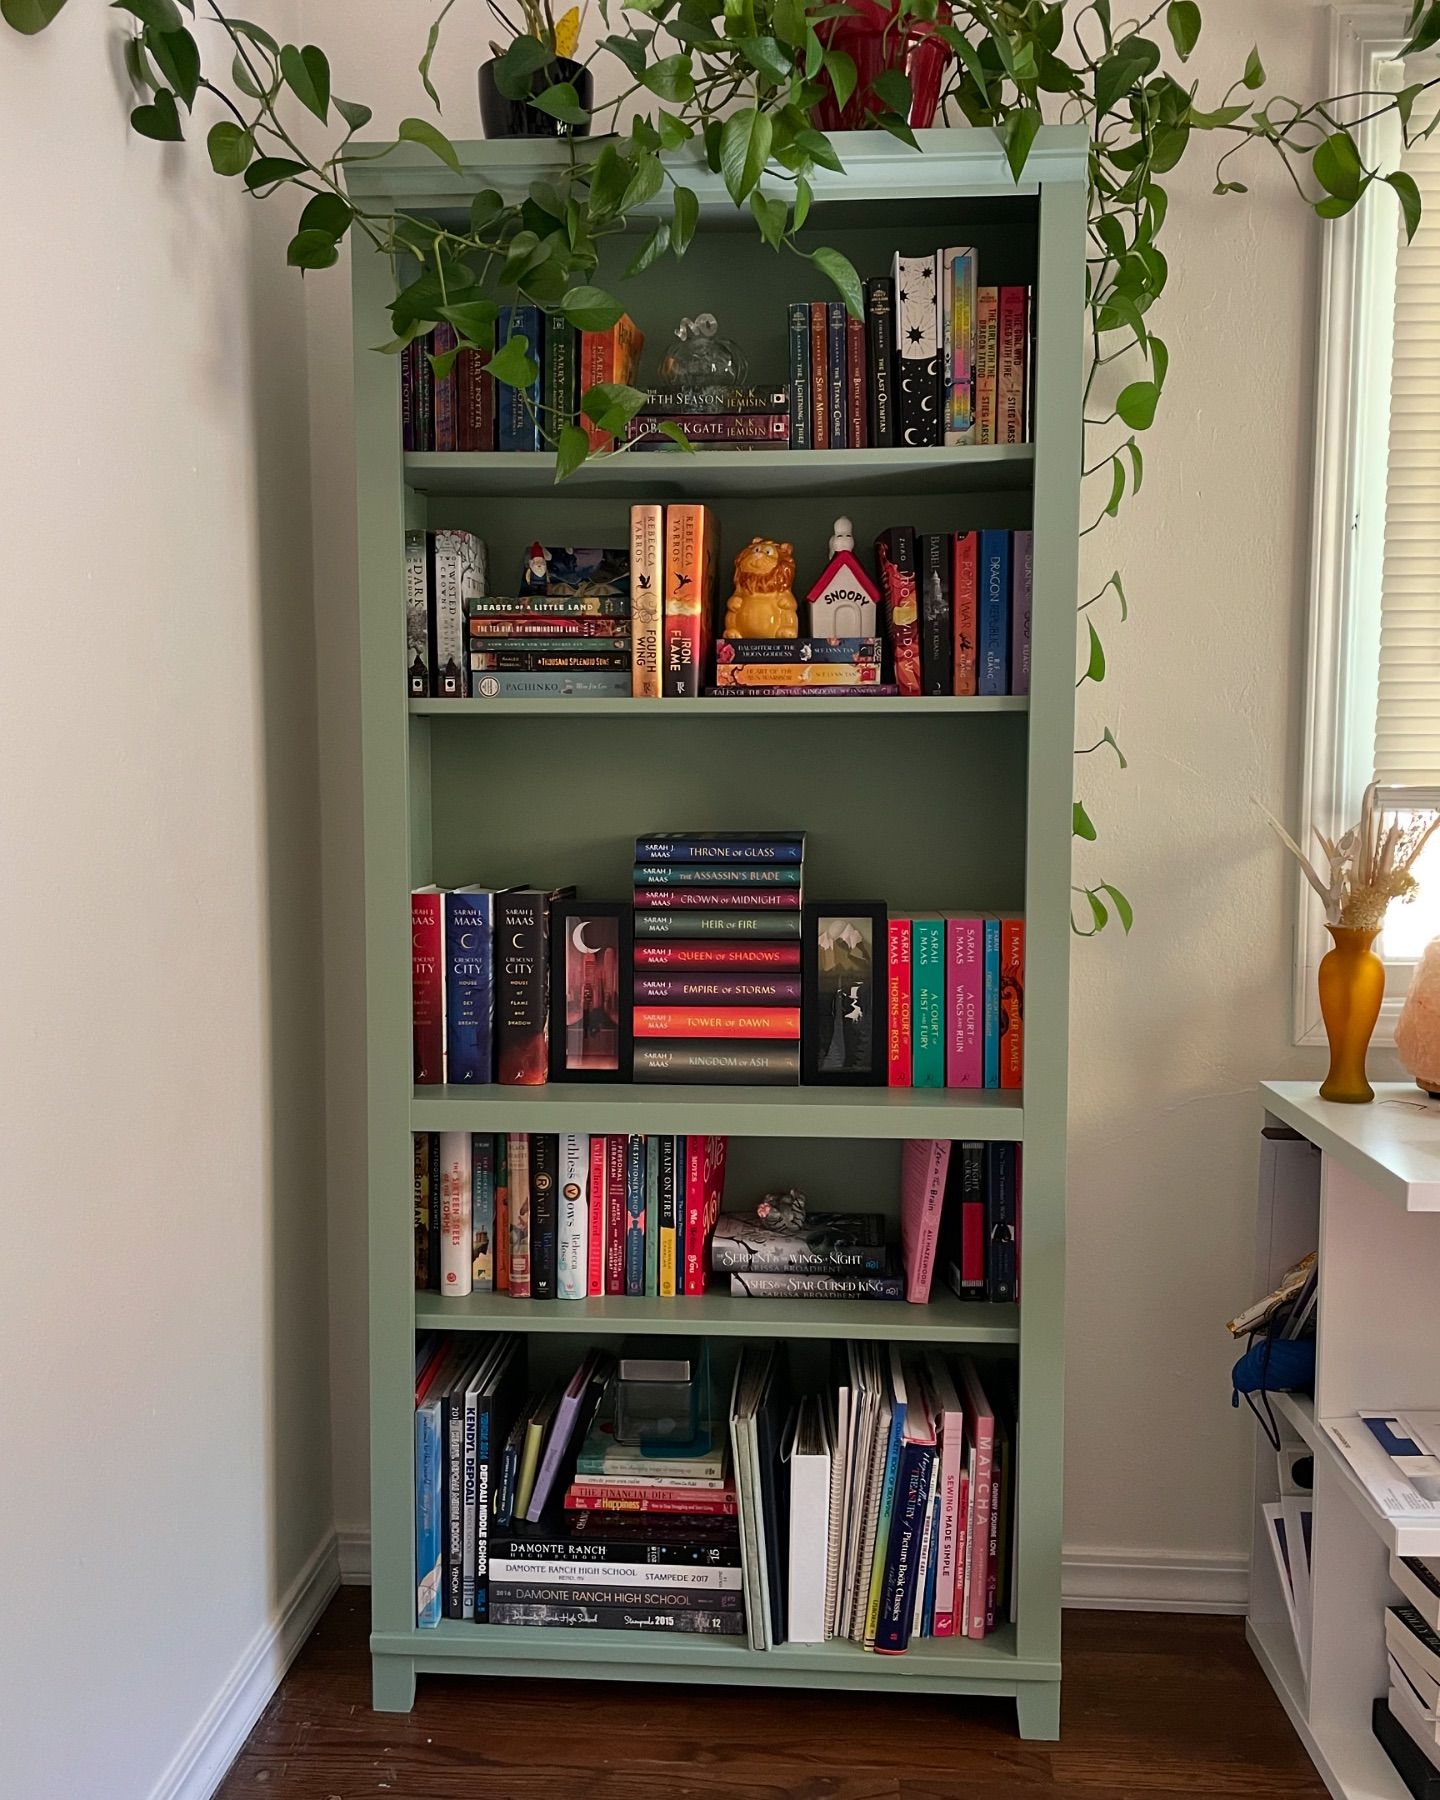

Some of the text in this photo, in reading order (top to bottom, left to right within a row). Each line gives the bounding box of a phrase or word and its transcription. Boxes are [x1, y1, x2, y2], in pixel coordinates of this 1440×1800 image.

[977, 319, 987, 379] DRAGON TATTOO
[986, 309, 996, 379] THE GIRL WITH THE
[1013, 348, 1022, 367] WHO
[556, 344, 565, 385] HARRY
[1003, 340, 1012, 379] WITH FIRE
[676, 392, 724, 405] SEASON
[853, 378, 862, 399] BATTLE
[877, 372, 888, 433] LAST OLYMPIAN
[474, 387, 483, 430] POTTER
[727, 398, 768, 408] JEMISIN
[795, 379, 806, 445] LIGHTNING THIEF
[815, 377, 824, 442] SEA MONSTERS
[981, 396, 989, 418] STIEG
[1007, 397, 1016, 419] STIEG
[693, 423, 724, 434] GATE
[727, 427, 768, 437] JEMISIN
[833, 410, 842, 437] CURSE
[635, 520, 643, 564] YARROS
[647, 516, 656, 568] REBECCA
[672, 519, 681, 563] YARROS
[685, 515, 694, 568] REBECCA
[413, 564, 424, 608] DARK
[447, 562, 457, 615] TWISTED
[989, 556, 1001, 602] DRAGON
[567, 603, 594, 611] LAND
[824, 589, 870, 607] SNOOPY
[960, 601, 972, 629] WAR
[636, 636, 646, 667] WING
[646, 630, 657, 674] FOURTH
[670, 629, 681, 672] FLAME
[681, 637, 692, 665] IRON
[987, 651, 995, 679] KUANG
[506, 682, 559, 691] PACHINKO
[689, 847, 775, 857] THRONE GLASS
[693, 871, 781, 881] ASSASSIN'S BLADE
[646, 891, 669, 899] SARAH
[651, 899, 671, 907] MAAS
[680, 894, 782, 905] CROWN MIDNIGHT
[453, 916, 483, 926] MAAS
[505, 916, 535, 926] MAAS
[649, 924, 670, 932] MAAS
[701, 919, 758, 929] HEIR FIRE
[643, 948, 666, 956] SARAH
[678, 951, 781, 962] QUEEN SHADOWS
[890, 936, 899, 966] MAAS
[901, 929, 910, 963] SARAH
[919, 936, 928, 966] MAAS
[930, 930, 939, 963] SARAH
[955, 936, 965, 965] MAAS
[966, 929, 976, 963] SARAH
[1010, 936, 1020, 966] MAAS
[453, 963, 483, 975] CITY
[505, 963, 535, 975] CITY
[648, 989, 669, 997] MAAS
[683, 985, 777, 995] EMPIRE STORMS
[688, 1017, 771, 1028] TOWER DAWN
[890, 976, 900, 1061] THORNS ROSES
[901, 1002, 909, 1036] COURT
[919, 988, 929, 1050] MIST FURY
[930, 1003, 939, 1036] COURT
[955, 984, 965, 1053] WINGS RUIN
[966, 1002, 975, 1036] COURT
[1010, 998, 1019, 1072] SILVER FLAMES
[644, 1052, 667, 1060] SARAH
[649, 1060, 670, 1068] MAAS
[689, 1056, 770, 1067] KINGDOM ASH
[631, 1151, 639, 1193] STATIONERY
[663, 1141, 672, 1218] BRAIN ON FIRE
[690, 1155, 699, 1183] MOYES
[964, 1160, 972, 1193] CIRCUS
[971, 1161, 980, 1190] NIGHT
[927, 1188, 938, 1213] Brain
[442, 1200, 451, 1234] SOMME
[560, 1240, 571, 1262] Ross
[571, 1234, 581, 1270] Rebecca
[687, 1208, 699, 1274] Me You
[788, 1251, 862, 1265] WINGS NIGHT
[920, 1242, 932, 1285] HAZELWOOD
[857, 1280, 884, 1291] KING
[465, 1407, 476, 1454] KENDYL
[465, 1457, 475, 1506] DEPOALI
[579, 1488, 673, 1500] THE FINANCIAL DIET
[976, 1435, 992, 1528] MATCHA
[602, 1498, 640, 1511] Happiness
[478, 1464, 489, 1577] DEPOALI MIDDLE SCHOOL
[942, 1474, 955, 1577] SEWING MADE SIMPLE
[510, 1543, 606, 1555] DAMONTE RANCH
[892, 1470, 920, 1622] TREASURY Picture Book Classics
[989, 1539, 997, 1557] LOVE
[451, 1566, 459, 1594] VENOM
[505, 1564, 638, 1577] DAMONTE RANCH HIGH SCHOOL
[645, 1572, 709, 1582] STAMPEDE 2017
[515, 1587, 690, 1605] DAMONTE RANCH HIGH SCHOOL
[654, 1615, 721, 1629] 2015 12
